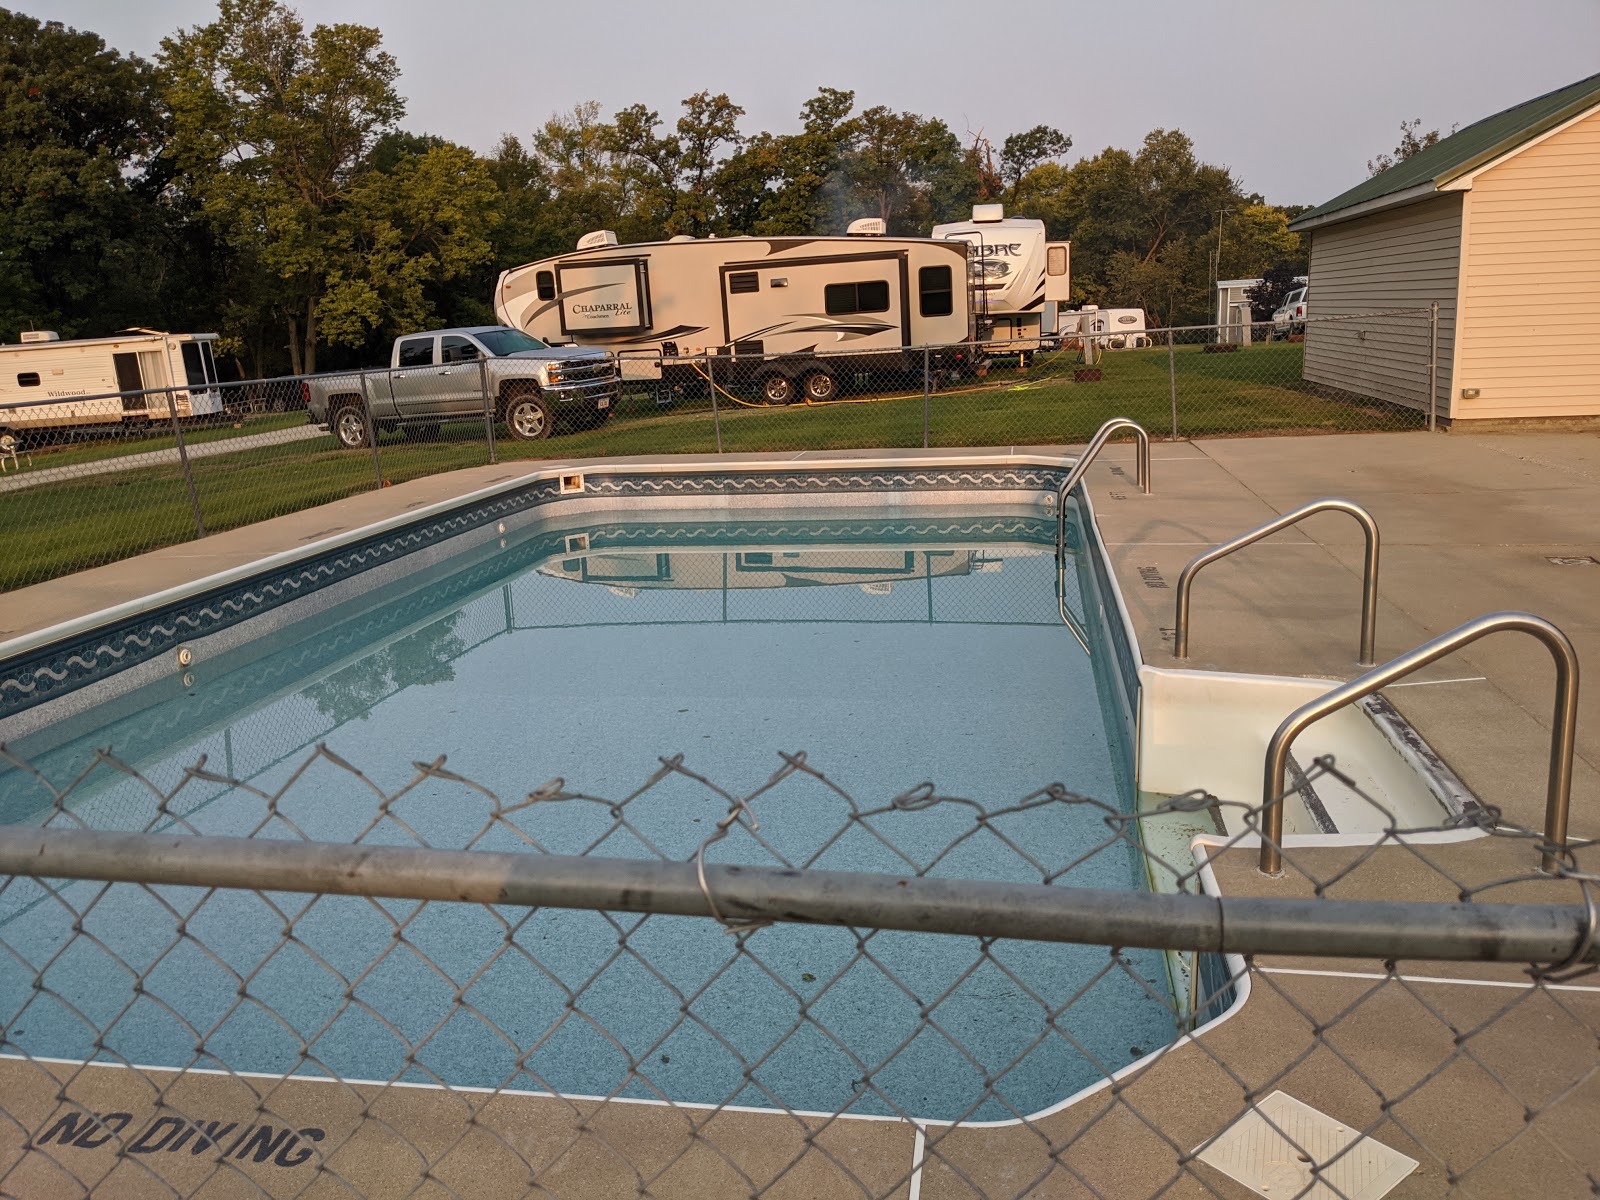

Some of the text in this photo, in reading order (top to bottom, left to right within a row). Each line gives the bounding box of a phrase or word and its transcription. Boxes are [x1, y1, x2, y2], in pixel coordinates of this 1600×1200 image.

[968, 243, 1022, 258] BRE
[572, 302, 633, 314] CHAPARRAL
[47, 389, 86, 397] Wildwood
[37, 1112, 326, 1168] NO DIVING
